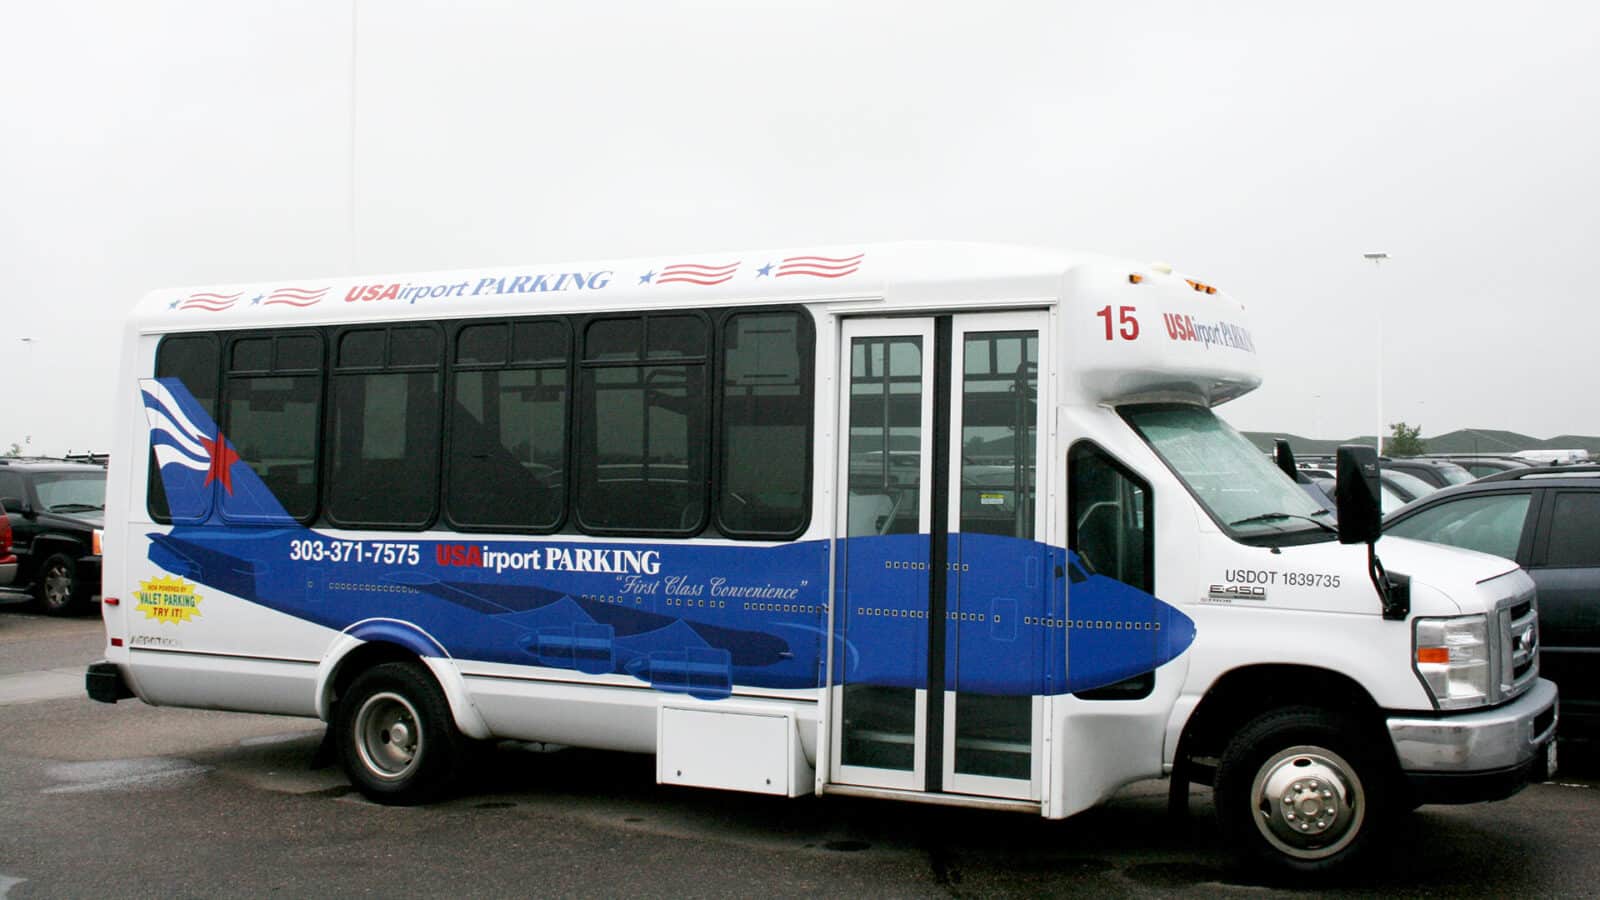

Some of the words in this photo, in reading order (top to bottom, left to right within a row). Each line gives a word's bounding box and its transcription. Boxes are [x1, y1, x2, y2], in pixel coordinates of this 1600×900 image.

[344, 282, 470, 304] USAirport
[471, 270, 613, 296] PARKING
[1096, 305, 1140, 341] 15
[1163, 313, 1220, 350] USAirport
[289, 539, 420, 565] 303-371-7575
[436, 544, 541, 573] USAirport
[545, 547, 661, 575] PARKING
[664, 575, 704, 597] Class
[1225, 569, 1278, 585] USDOT
[1282, 572, 1341, 588] 1839735
[140, 592, 162, 605] VALET
[163, 593, 196, 607] PARKING
[153, 607, 169, 617] TRY
[171, 608, 183, 618] IT!
